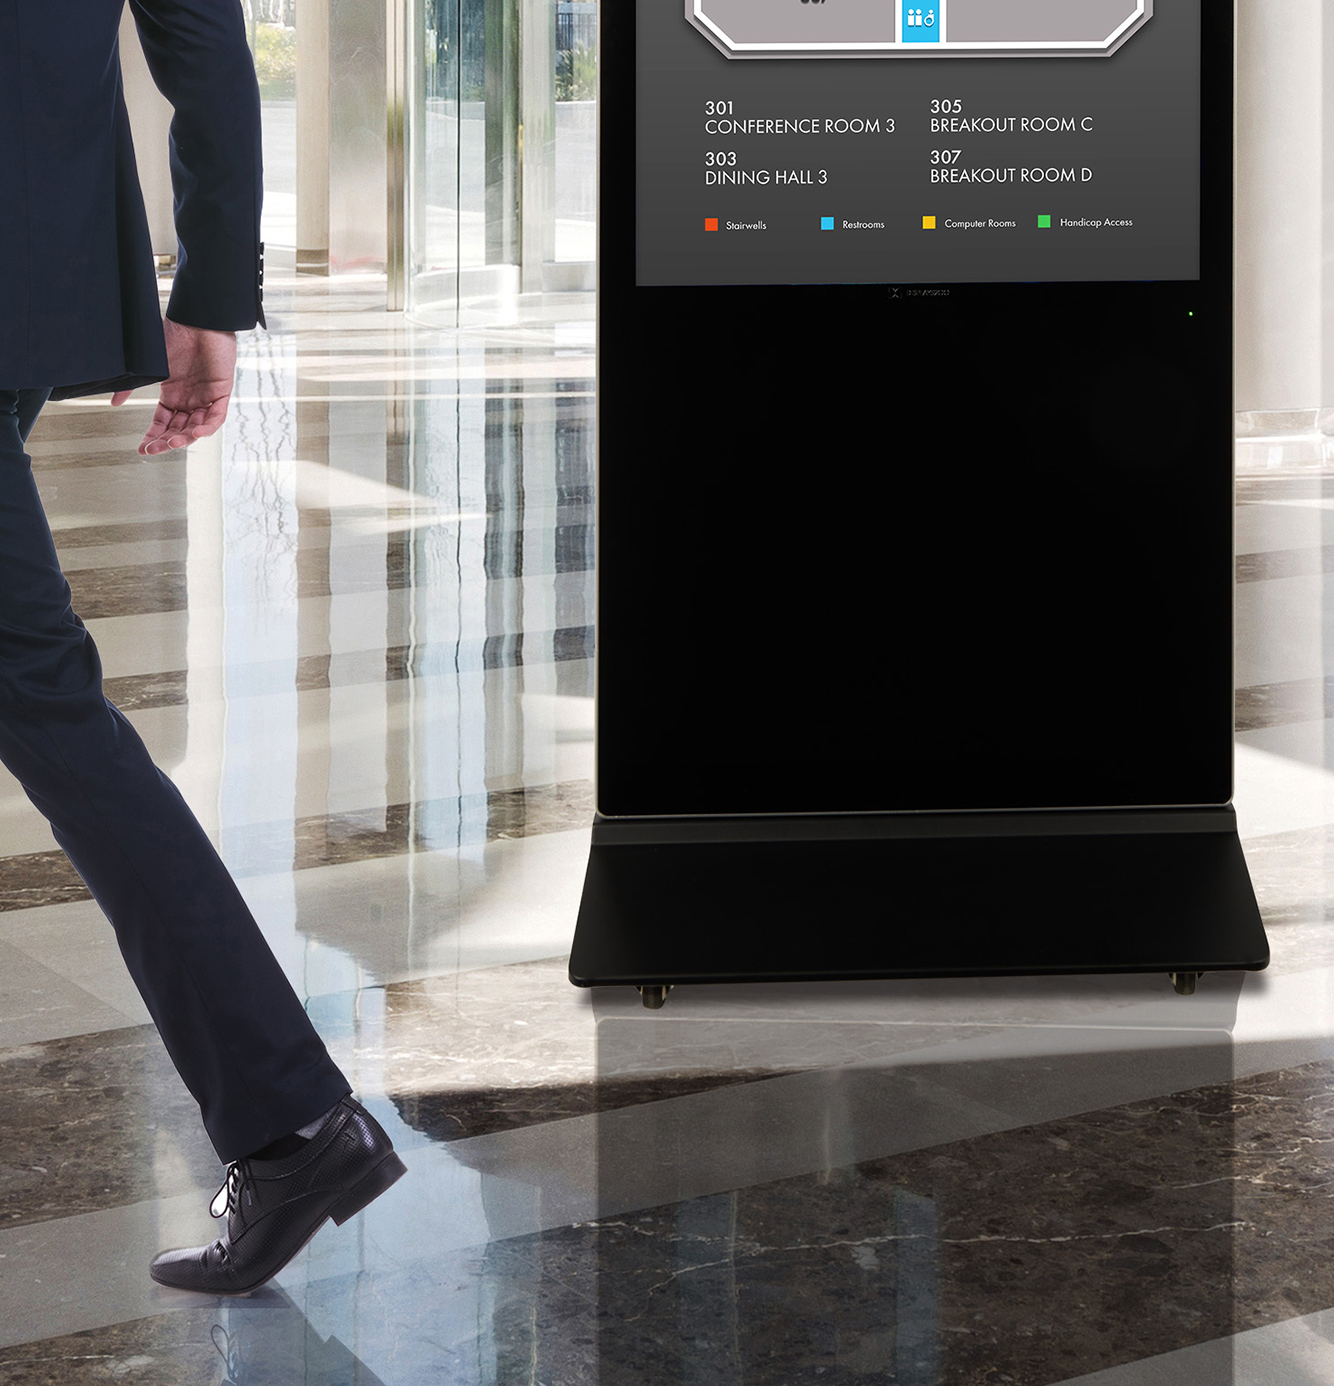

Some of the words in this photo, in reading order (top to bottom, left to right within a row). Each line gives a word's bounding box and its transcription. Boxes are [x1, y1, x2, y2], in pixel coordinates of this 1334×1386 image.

[705, 101, 733, 116] 301
[930, 99, 962, 114] 305
[705, 118, 820, 134] CONFERENCE
[825, 118, 881, 133] ROOM
[885, 118, 895, 133] 3
[930, 117, 1016, 133] BREAKOUT
[1021, 116, 1076, 132] ROOM
[1080, 116, 1093, 132] C
[705, 151, 737, 167] 303
[930, 150, 961, 165] 307
[705, 169, 770, 185] DINING
[775, 169, 814, 185] HALL
[818, 169, 828, 185] 3
[930, 168, 1016, 183] BREAKOUT
[1020, 167, 1076, 183] ROOM
[1081, 167, 1093, 182] D
[725, 220, 767, 230] Stairwells
[842, 220, 885, 229] Restrooms
[944, 218, 987, 231] Computer
[988, 218, 1017, 228] Rooms
[1060, 217, 1102, 230] Handicap
[1103, 217, 1134, 227] Access
